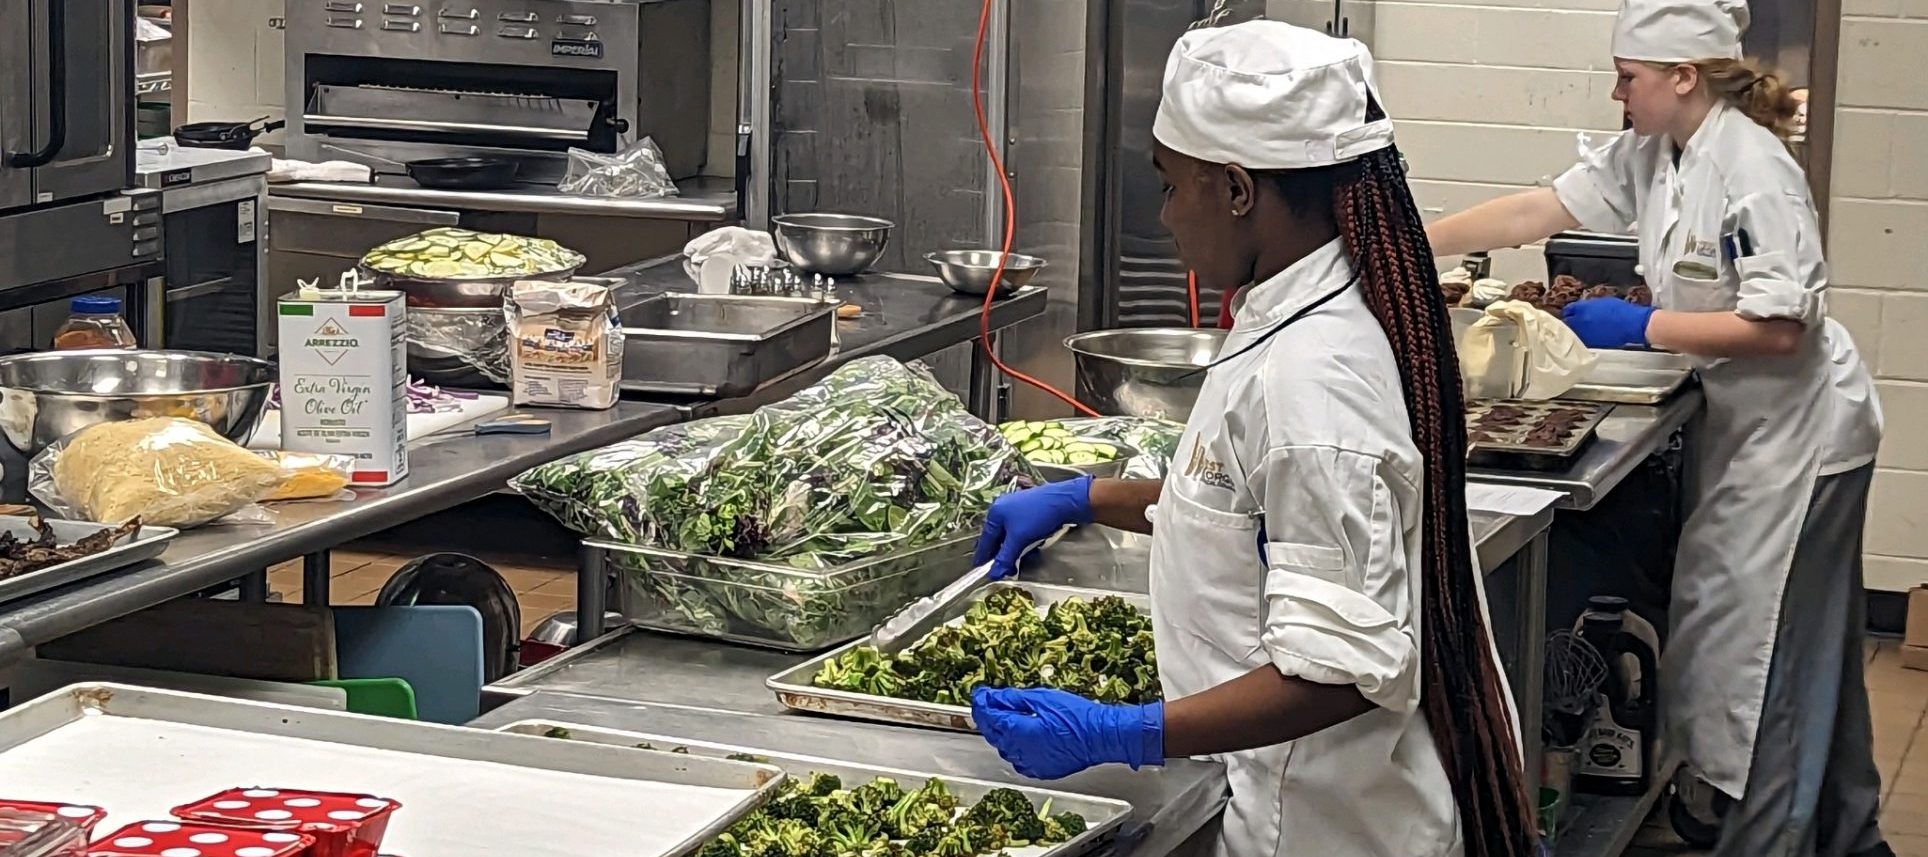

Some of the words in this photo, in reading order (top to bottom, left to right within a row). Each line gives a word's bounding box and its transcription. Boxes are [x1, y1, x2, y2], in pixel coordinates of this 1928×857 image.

[304, 338, 358, 347] ARREZZIO
[294, 377, 326, 394] Extra
[328, 377, 371, 399] Virgin
[305, 398, 336, 415] Olive
